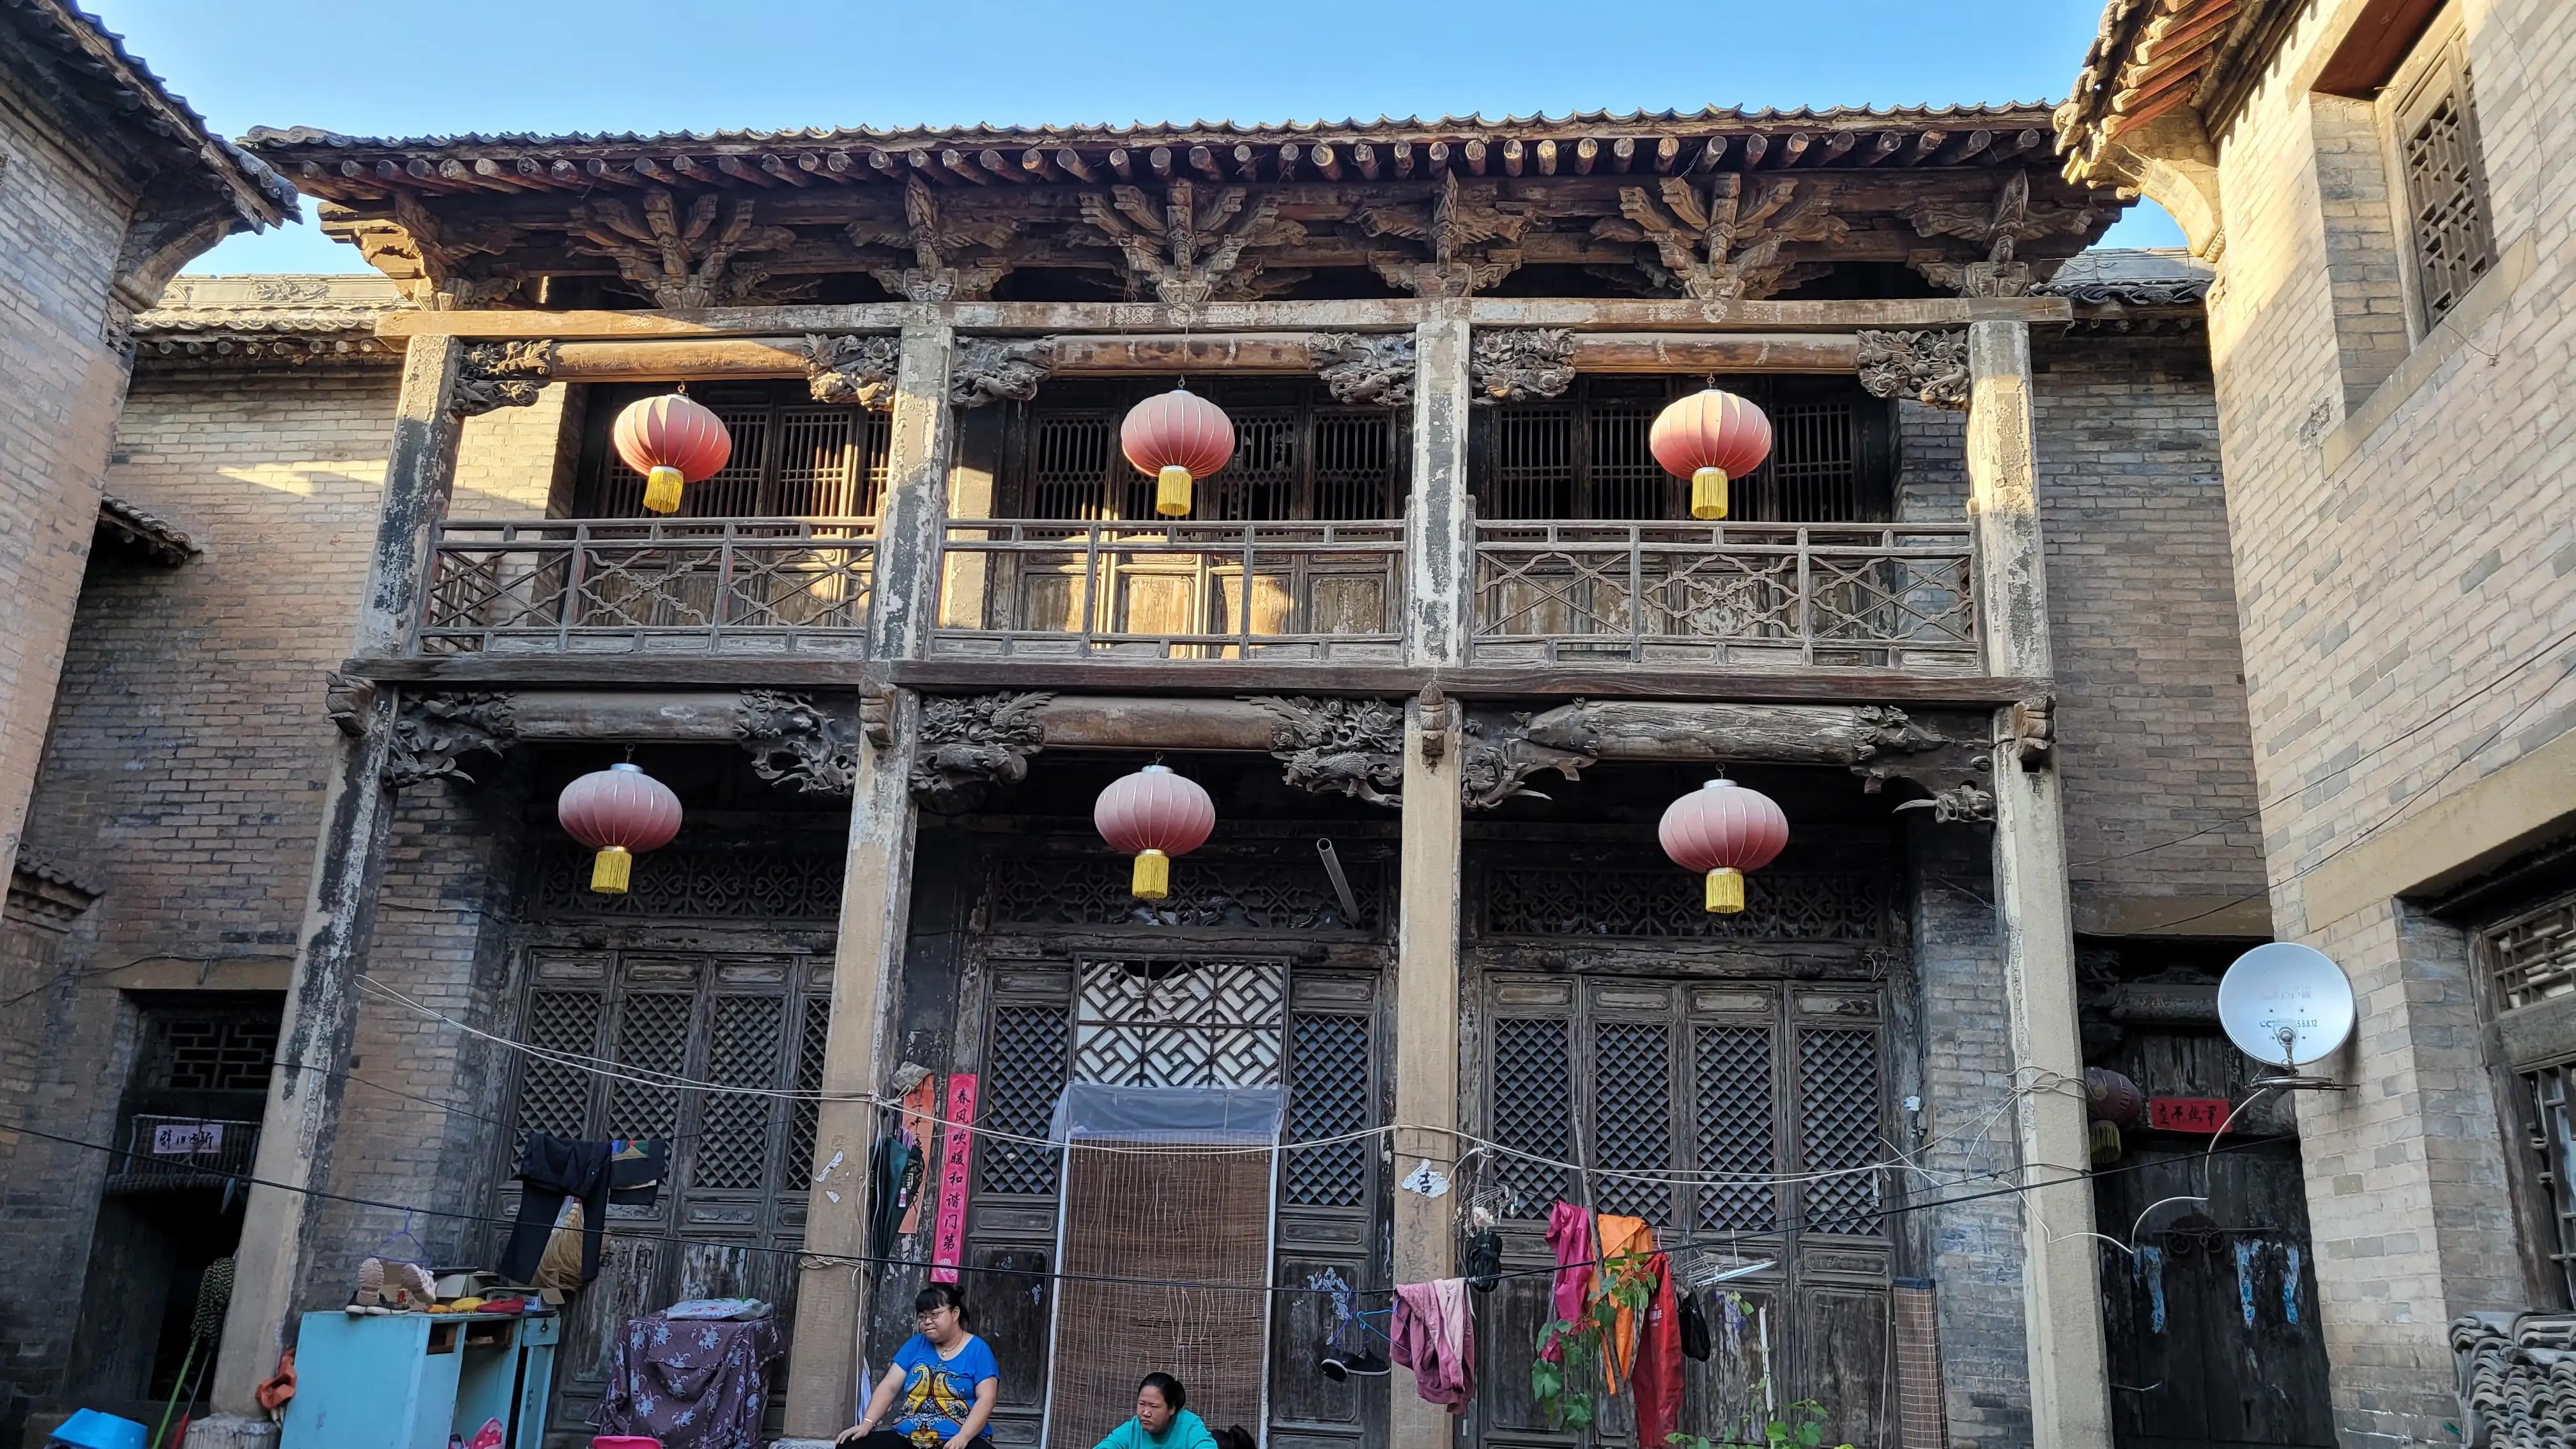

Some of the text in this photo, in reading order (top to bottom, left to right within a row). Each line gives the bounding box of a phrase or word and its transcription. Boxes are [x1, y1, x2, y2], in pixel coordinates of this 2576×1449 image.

[942, 1087, 972, 1253] 春风吹暖和谐门第
